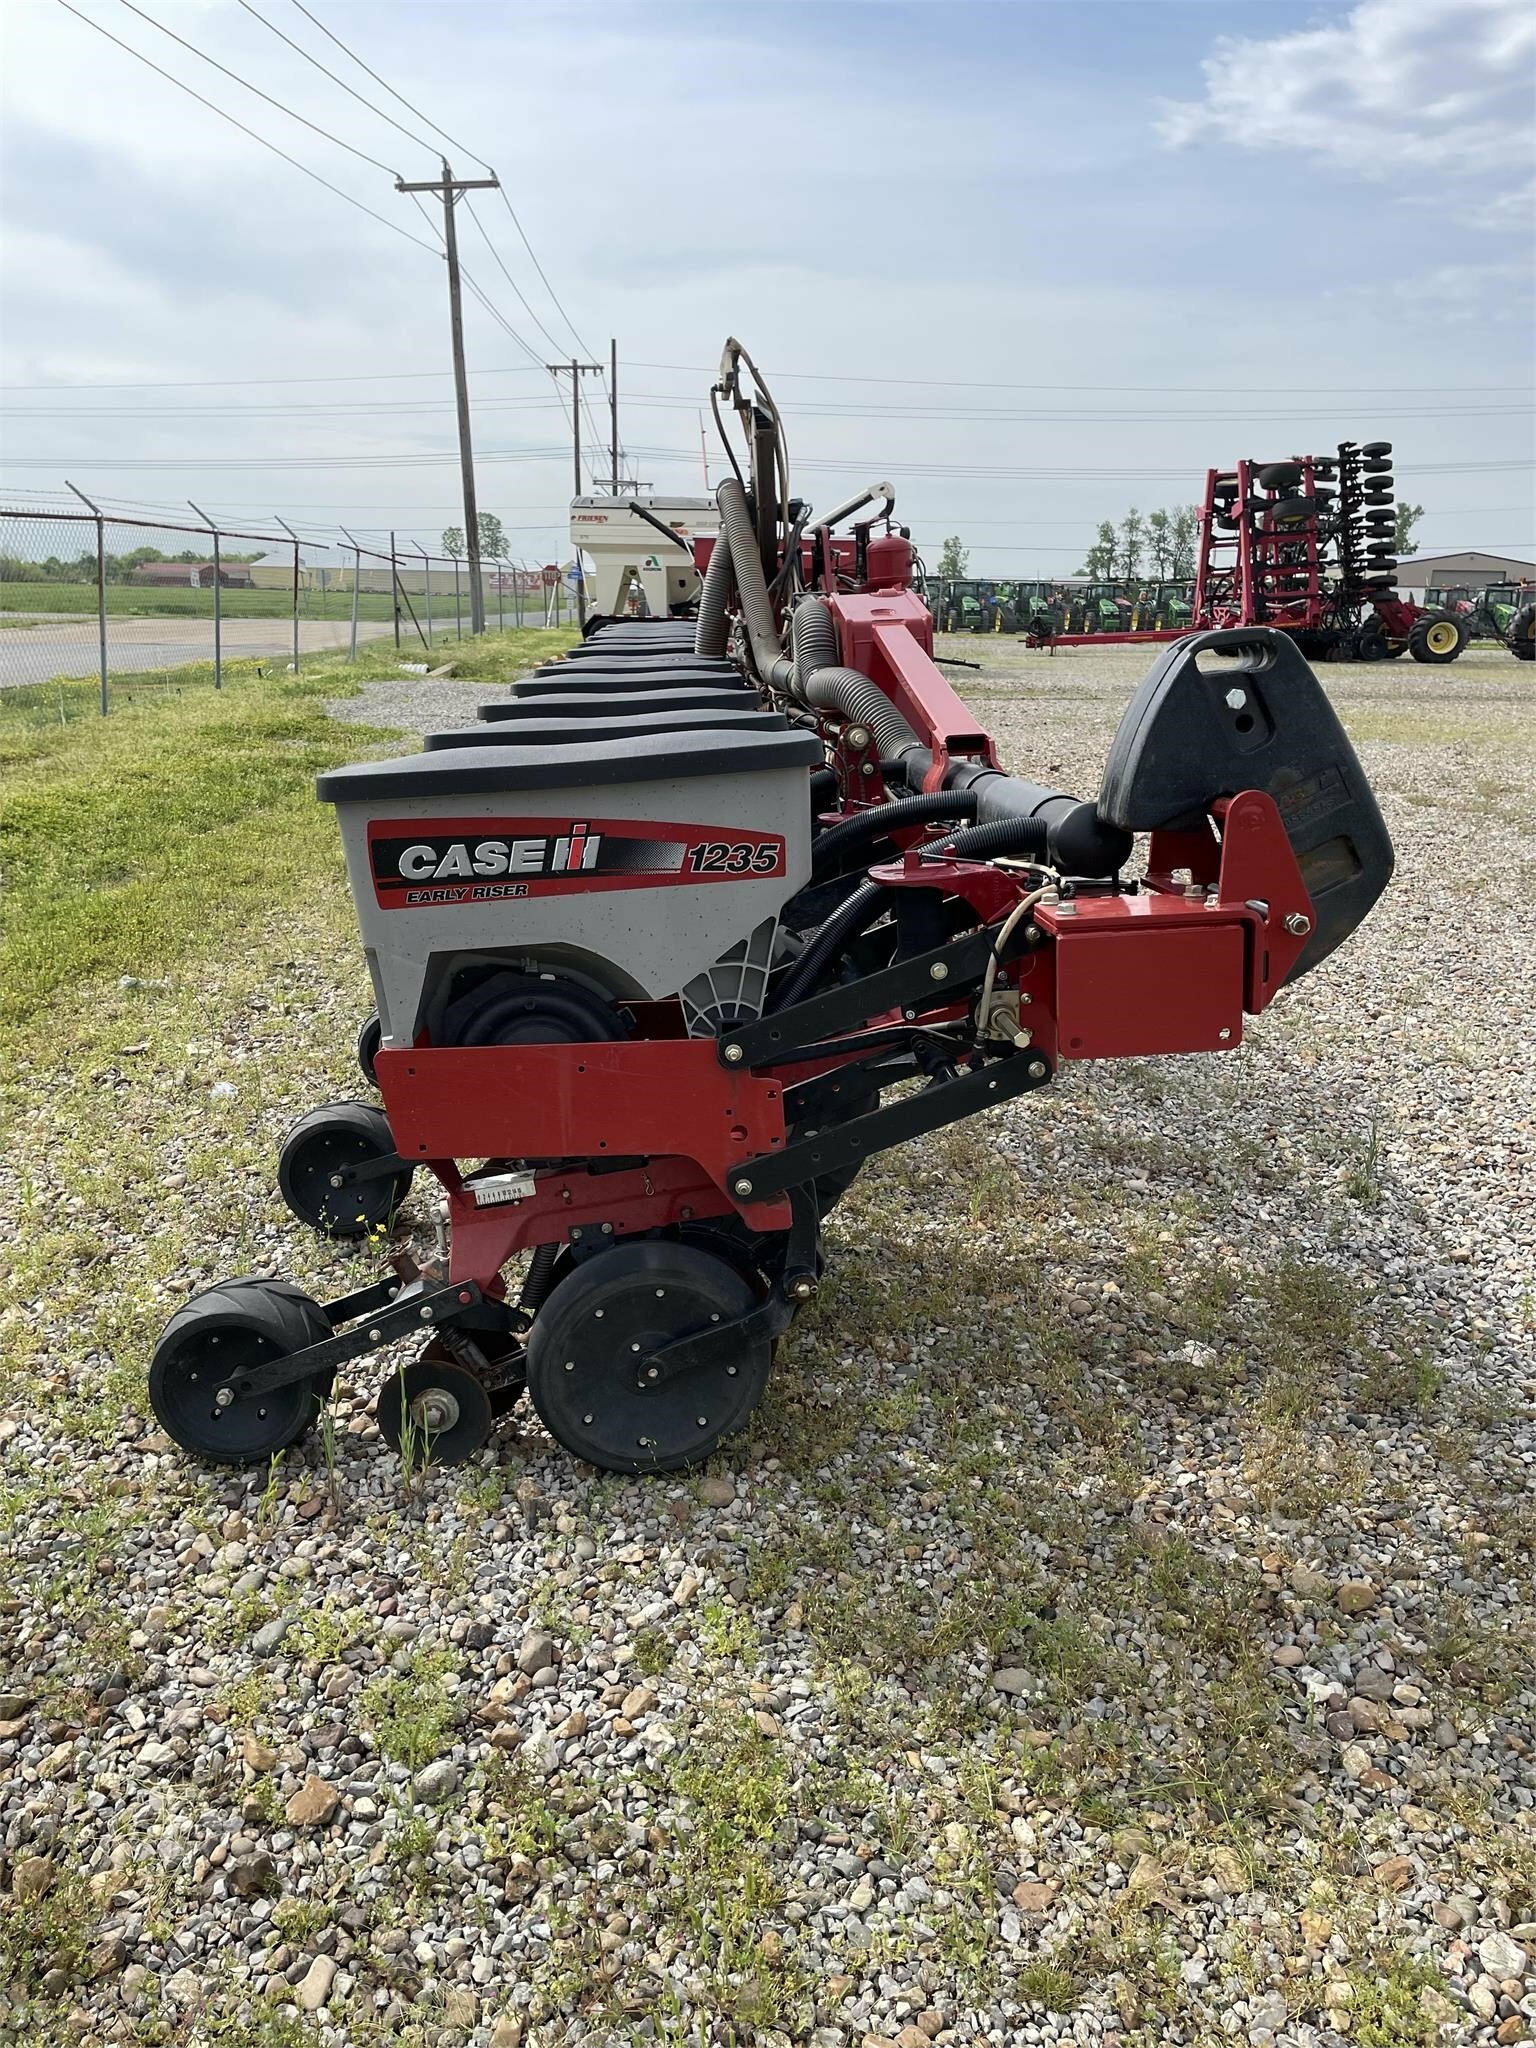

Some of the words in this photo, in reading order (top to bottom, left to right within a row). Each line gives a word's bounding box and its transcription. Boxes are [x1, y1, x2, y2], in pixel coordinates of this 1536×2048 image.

[400, 840, 547, 880] CASE
[688, 842, 780, 873] 1235
[406, 887, 469, 903] EARLY
[472, 884, 528, 899] RISER
